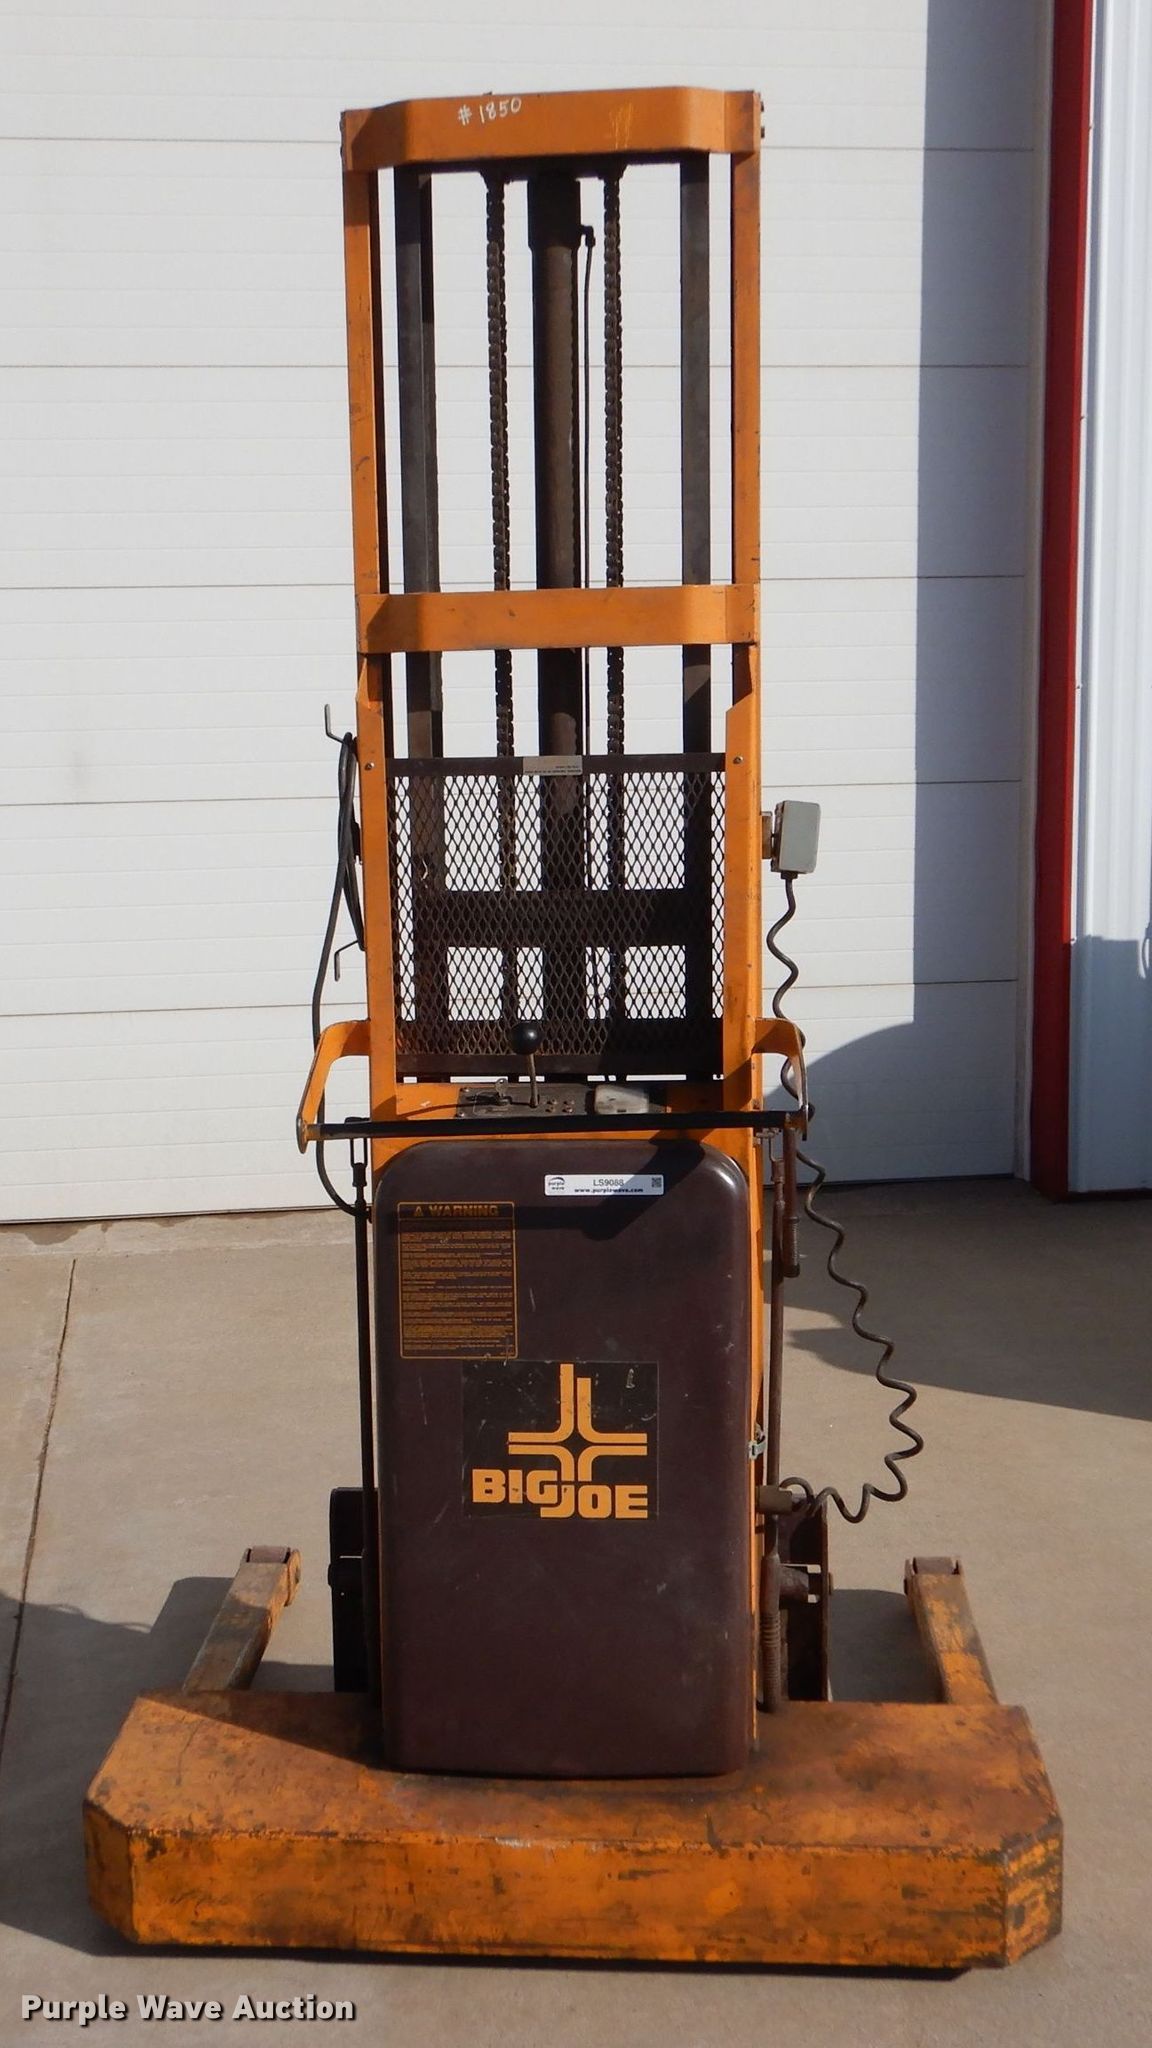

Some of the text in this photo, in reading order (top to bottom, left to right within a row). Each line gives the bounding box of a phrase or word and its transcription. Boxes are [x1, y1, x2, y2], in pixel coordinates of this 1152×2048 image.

[428, 1204, 499, 1217] WARNING
[472, 1469, 648, 1518] BIG JOE
